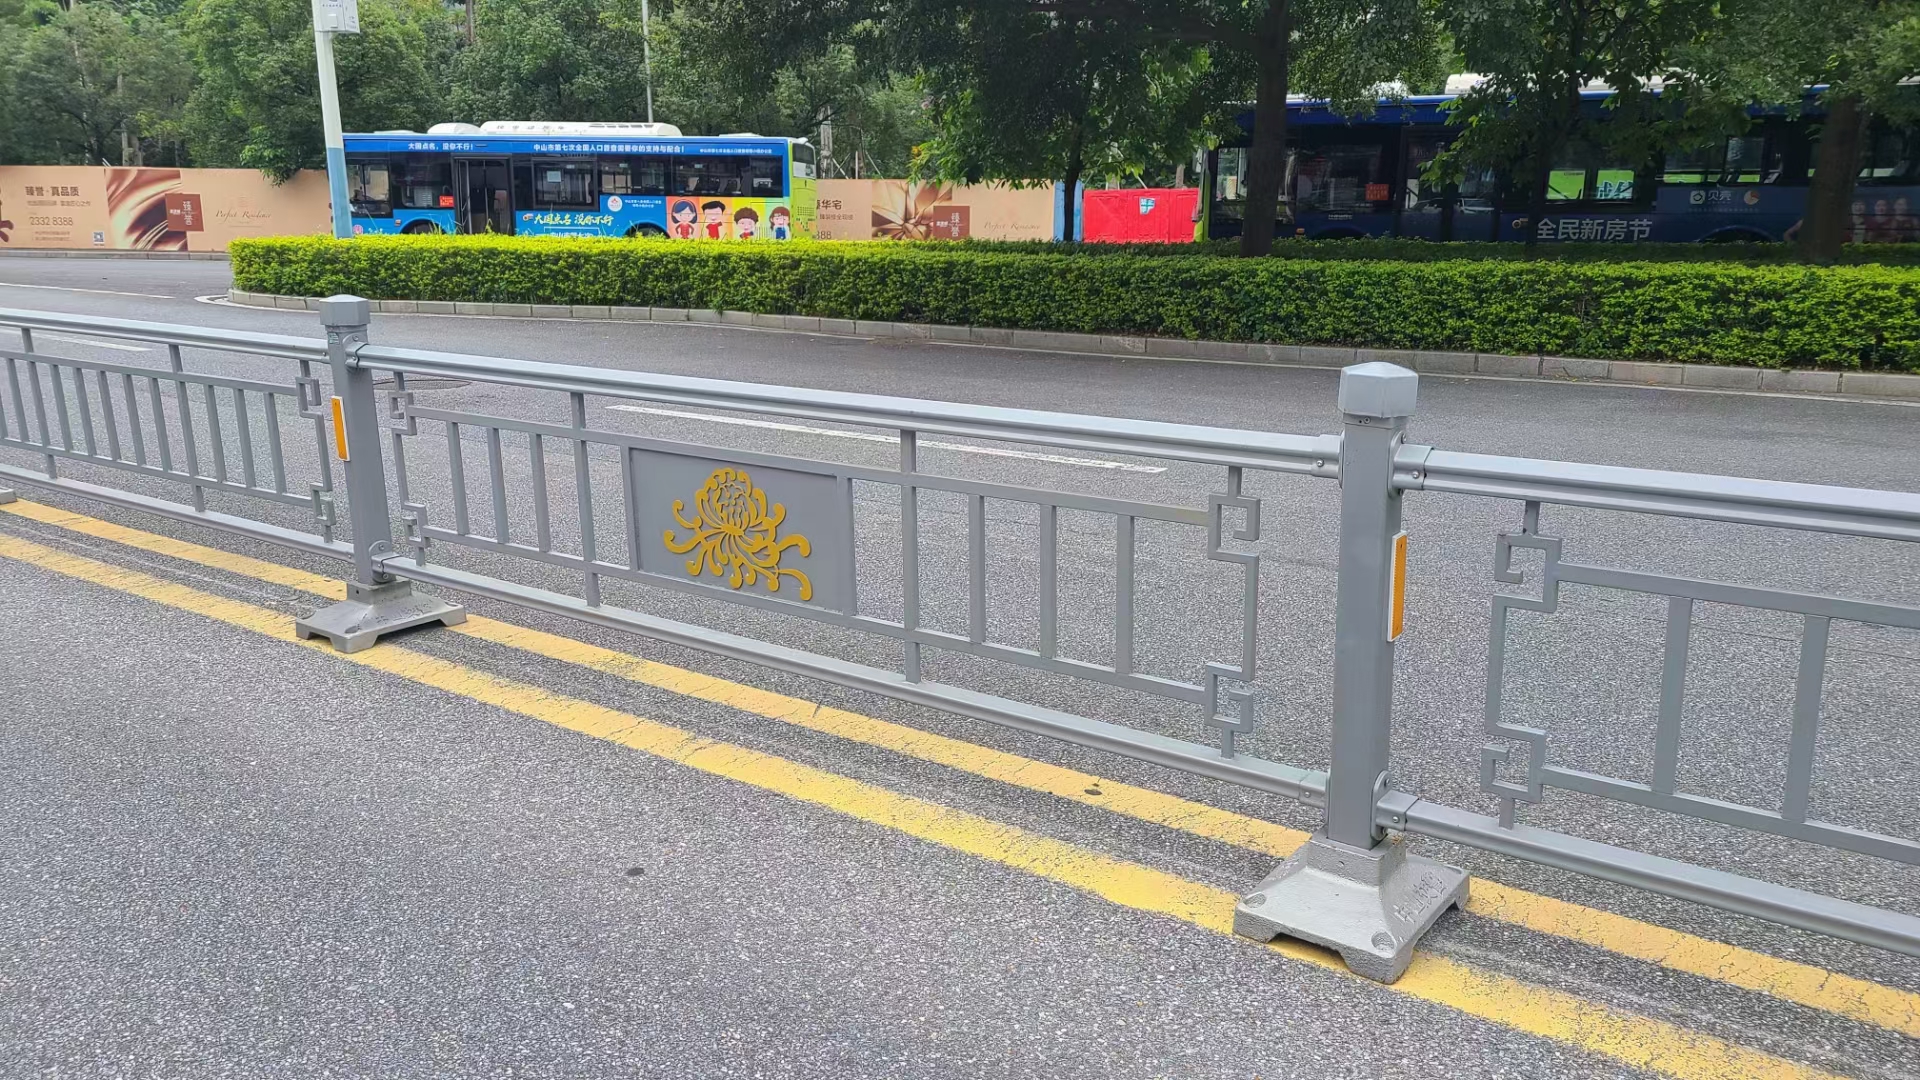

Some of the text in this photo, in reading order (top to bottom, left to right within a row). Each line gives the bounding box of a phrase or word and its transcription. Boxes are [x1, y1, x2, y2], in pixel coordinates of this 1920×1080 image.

[1536, 218, 1653, 241] 全民新房节
